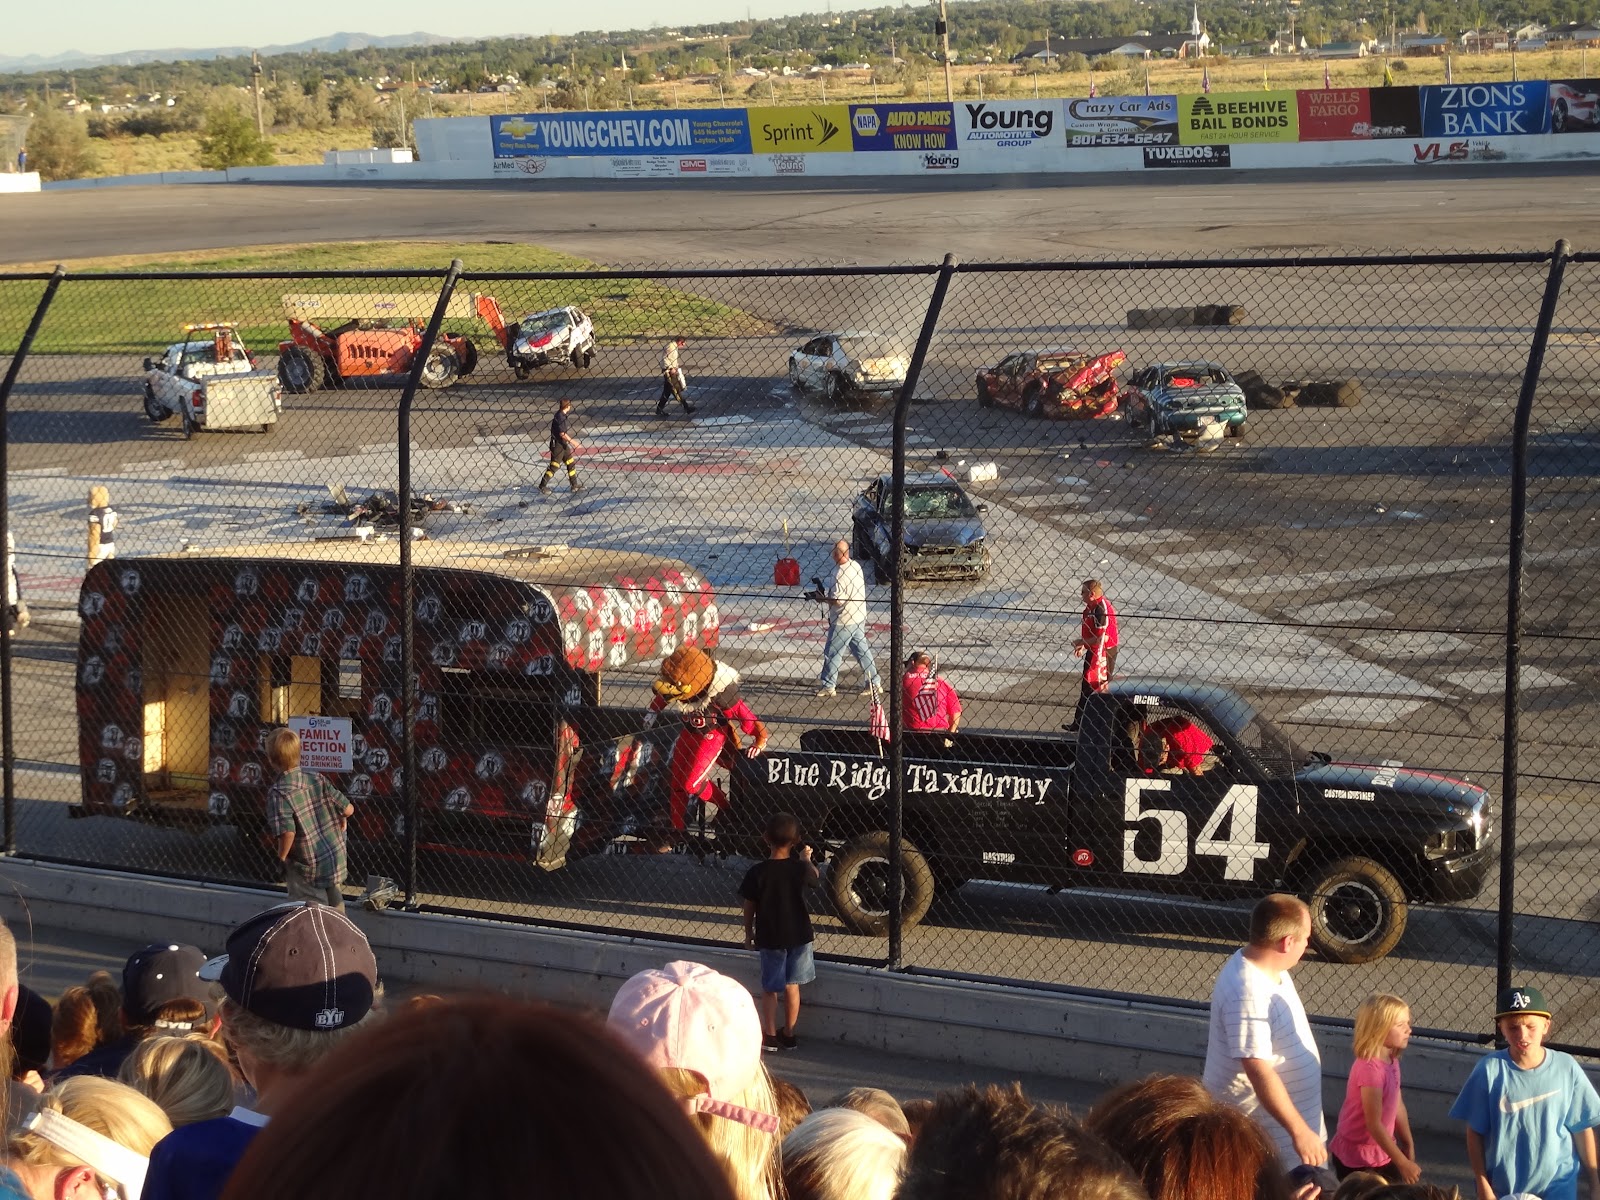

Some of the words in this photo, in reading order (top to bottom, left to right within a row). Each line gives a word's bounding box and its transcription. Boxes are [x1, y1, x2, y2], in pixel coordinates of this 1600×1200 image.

[1309, 92, 1360, 104] WELLS
[1441, 85, 1526, 109] ZIONS
[1069, 100, 1115, 120] Crazy
[1120, 102, 1141, 112] Car
[1147, 101, 1171, 111] Ads
[1217, 101, 1287, 114] BEEHIVE
[1309, 104, 1359, 117] FARGO
[857, 115, 876, 128] NAPA
[886, 112, 916, 126] AUTO
[917, 111, 951, 126] PARTS
[965, 103, 1053, 137] Young
[1191, 117, 1227, 130] BAIL
[1232, 115, 1288, 129] BONDS
[1442, 110, 1527, 135] BANK
[540, 119, 692, 148] YOUNGCHEV.COM
[763, 123, 814, 145] Sprint
[894, 134, 920, 149] KNOW
[924, 133, 945, 148] HOW
[970, 131, 1032, 139] AUTOMOTIVE
[1072, 133, 1173, 145] 801-634-6247
[1146, 147, 1213, 159] TUXEDOS
[1413, 142, 1469, 160] VLS
[774, 160, 805, 173] Young
[925, 155, 959, 169] Young
[299, 729, 341, 740] FAMILY
[299, 742, 347, 753] ECTION
[767, 758, 820, 787] Blue
[907, 765, 1052, 805] Taxidermy
[1123, 777, 1271, 881] 54
[315, 1008, 344, 1027] BYU
